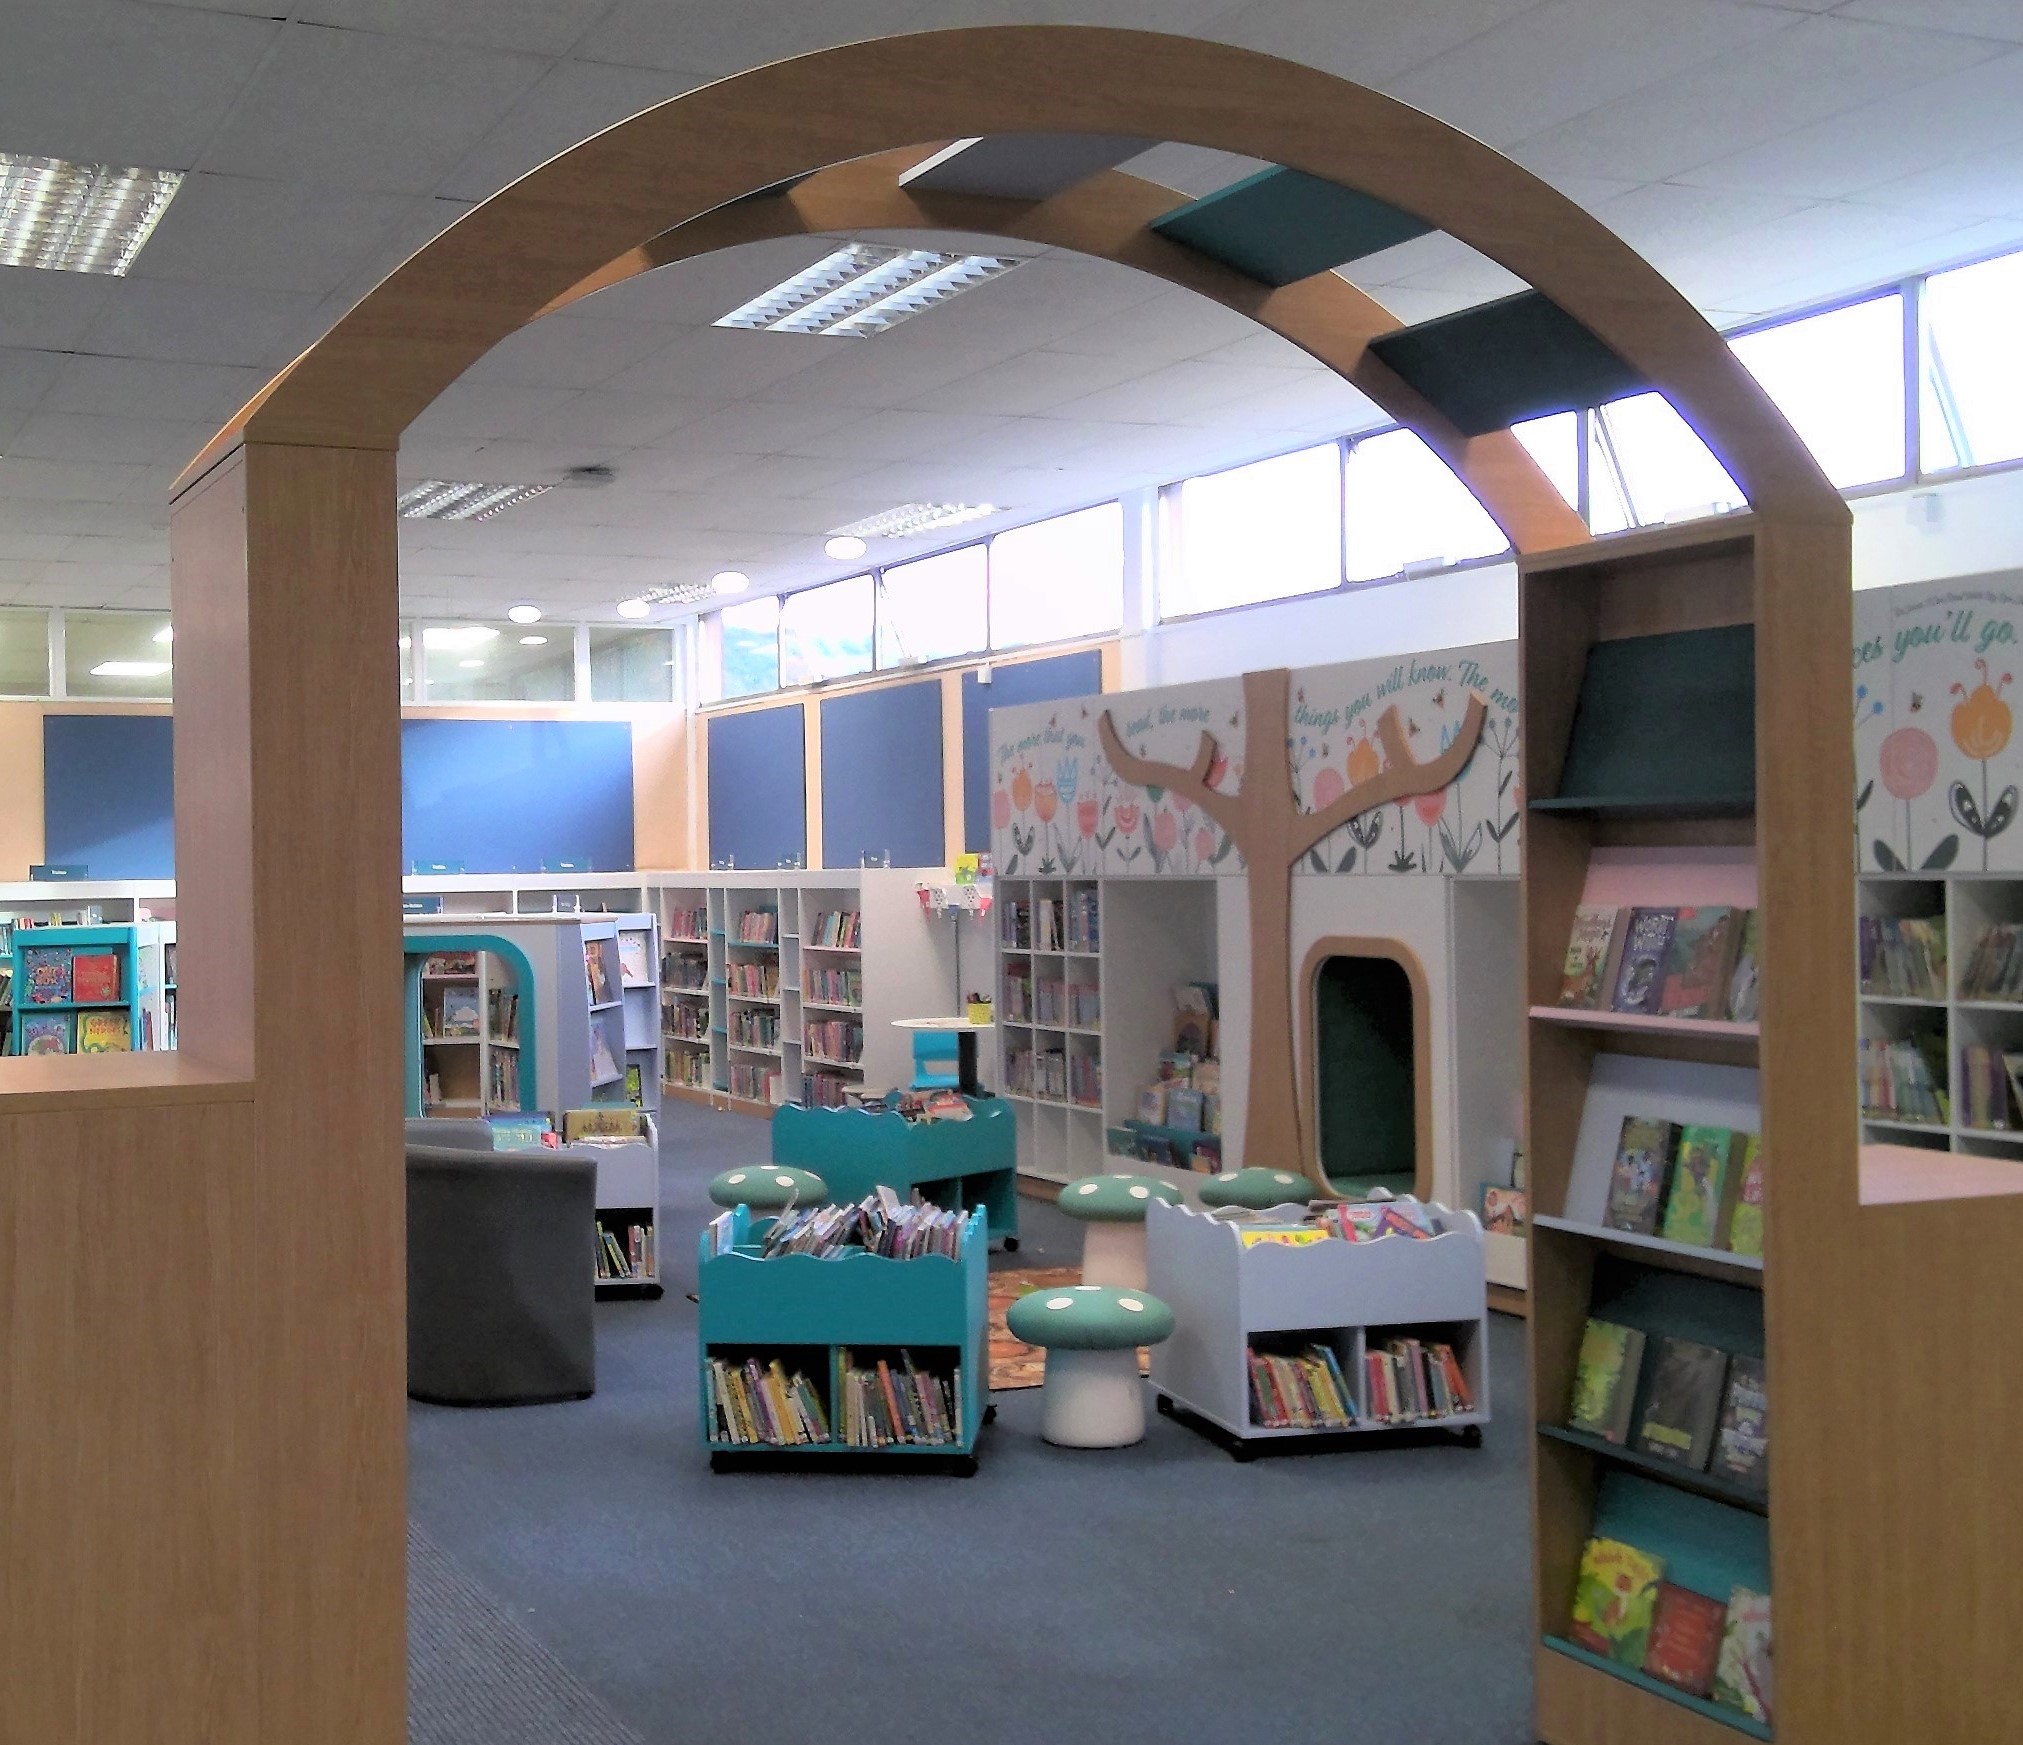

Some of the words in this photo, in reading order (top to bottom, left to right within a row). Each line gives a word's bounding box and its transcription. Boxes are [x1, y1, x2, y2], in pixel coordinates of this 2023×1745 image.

[1892, 610, 1973, 663] you'll
[1294, 705, 1338, 735] things
[1345, 693, 1372, 729] you
[1377, 665, 1403, 699] will
[1458, 659, 1488, 691] The
